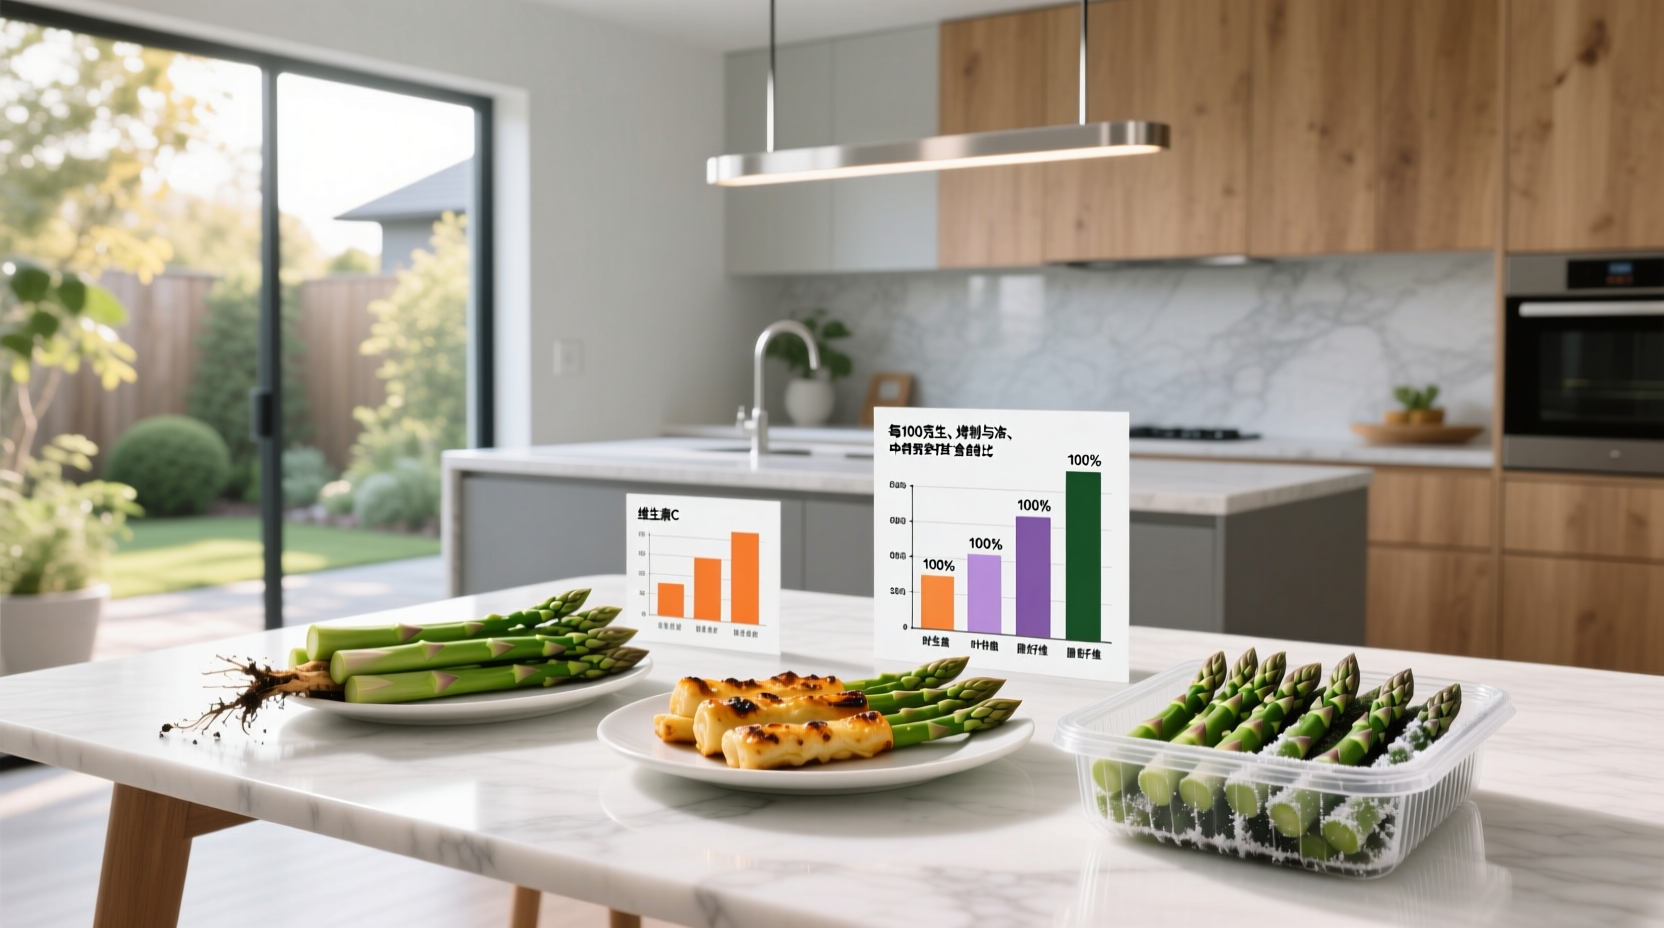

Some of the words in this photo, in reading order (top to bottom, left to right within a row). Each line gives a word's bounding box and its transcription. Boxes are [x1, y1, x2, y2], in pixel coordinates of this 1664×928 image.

[1067, 453, 1102, 467] 100%
[1017, 498, 1052, 513] 100%
[968, 537, 1003, 551] 100%
[922, 558, 956, 572] 100%
